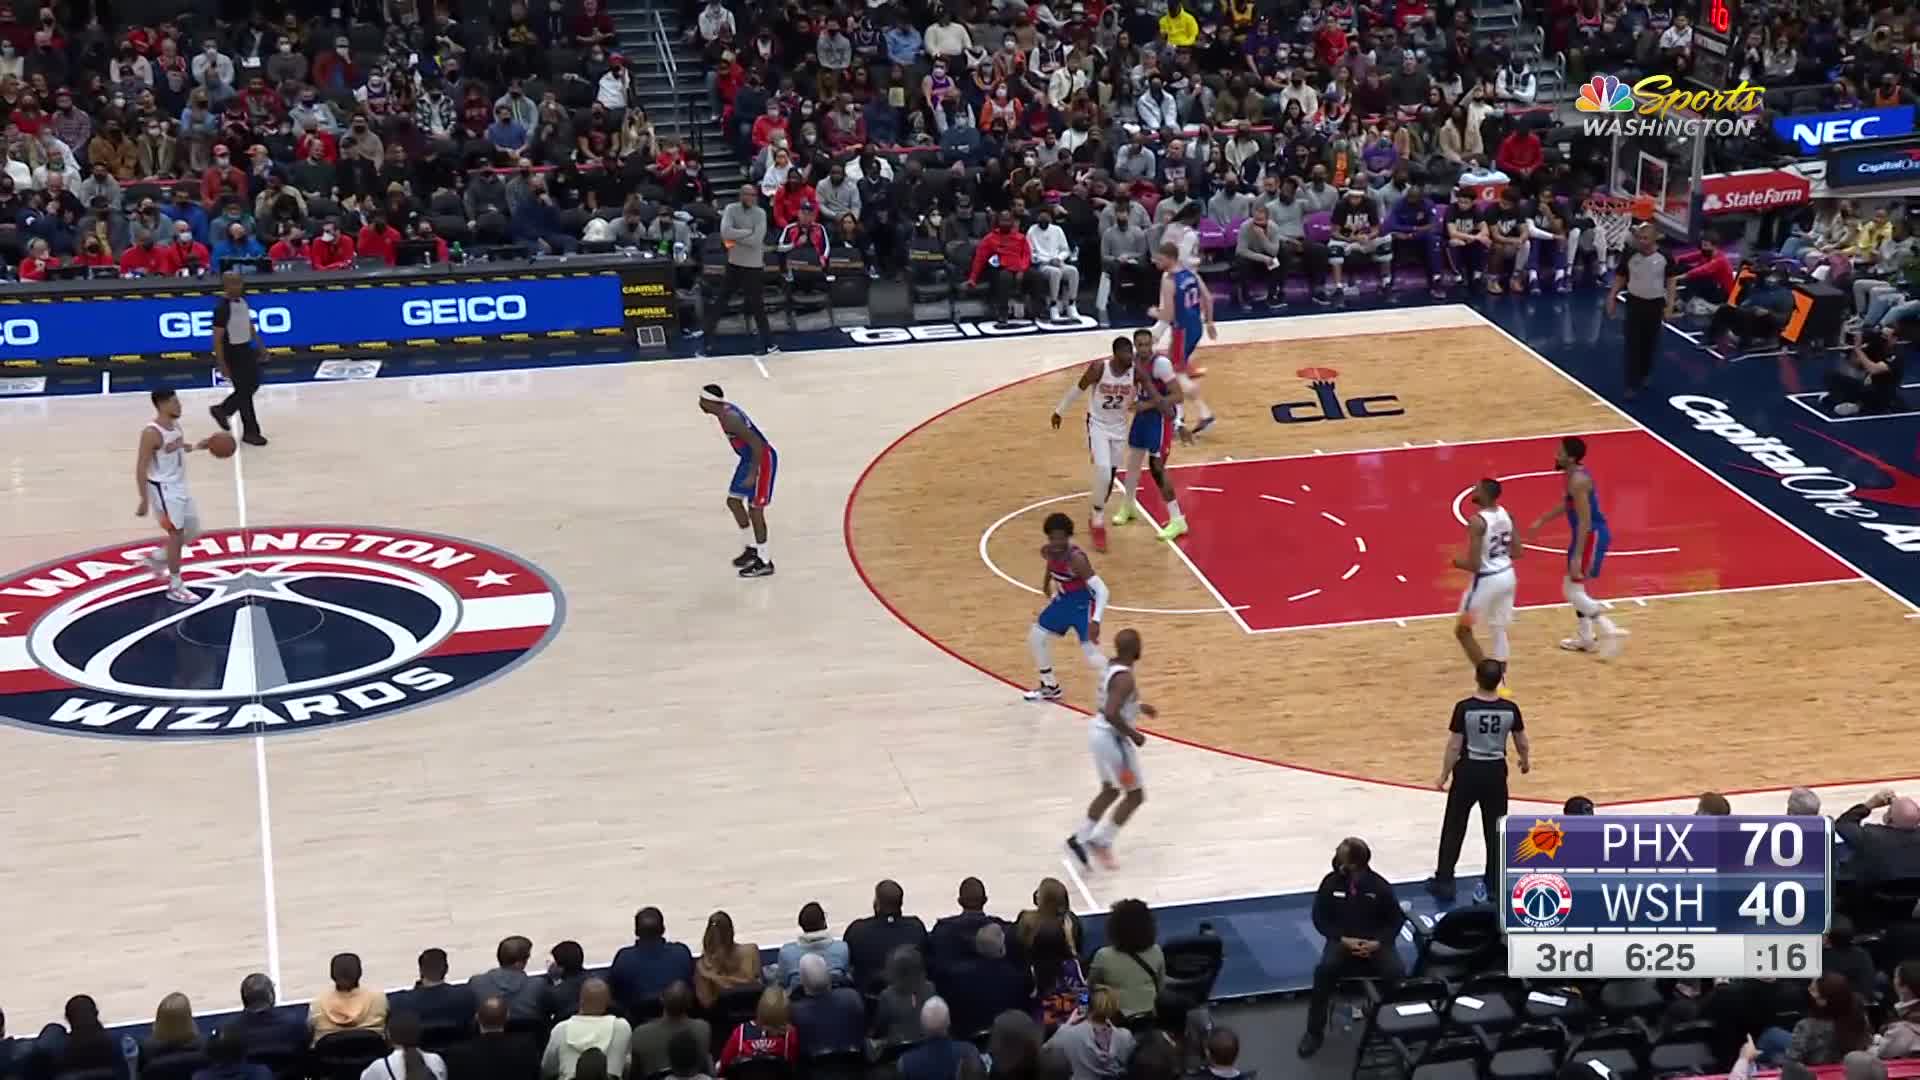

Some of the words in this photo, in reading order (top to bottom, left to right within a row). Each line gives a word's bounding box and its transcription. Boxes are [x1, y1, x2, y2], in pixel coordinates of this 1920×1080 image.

[1792, 116, 1881, 146] NEC
[159, 306, 292, 339] GEO
[402, 294, 527, 326] GEICO
[1102, 395, 1125, 410] 22
[1489, 531, 1512, 559] 25
[2, 532, 476, 600] WASHINGTON
[49, 665, 455, 730] WIZARDS
[1479, 715, 1501, 734] 52
